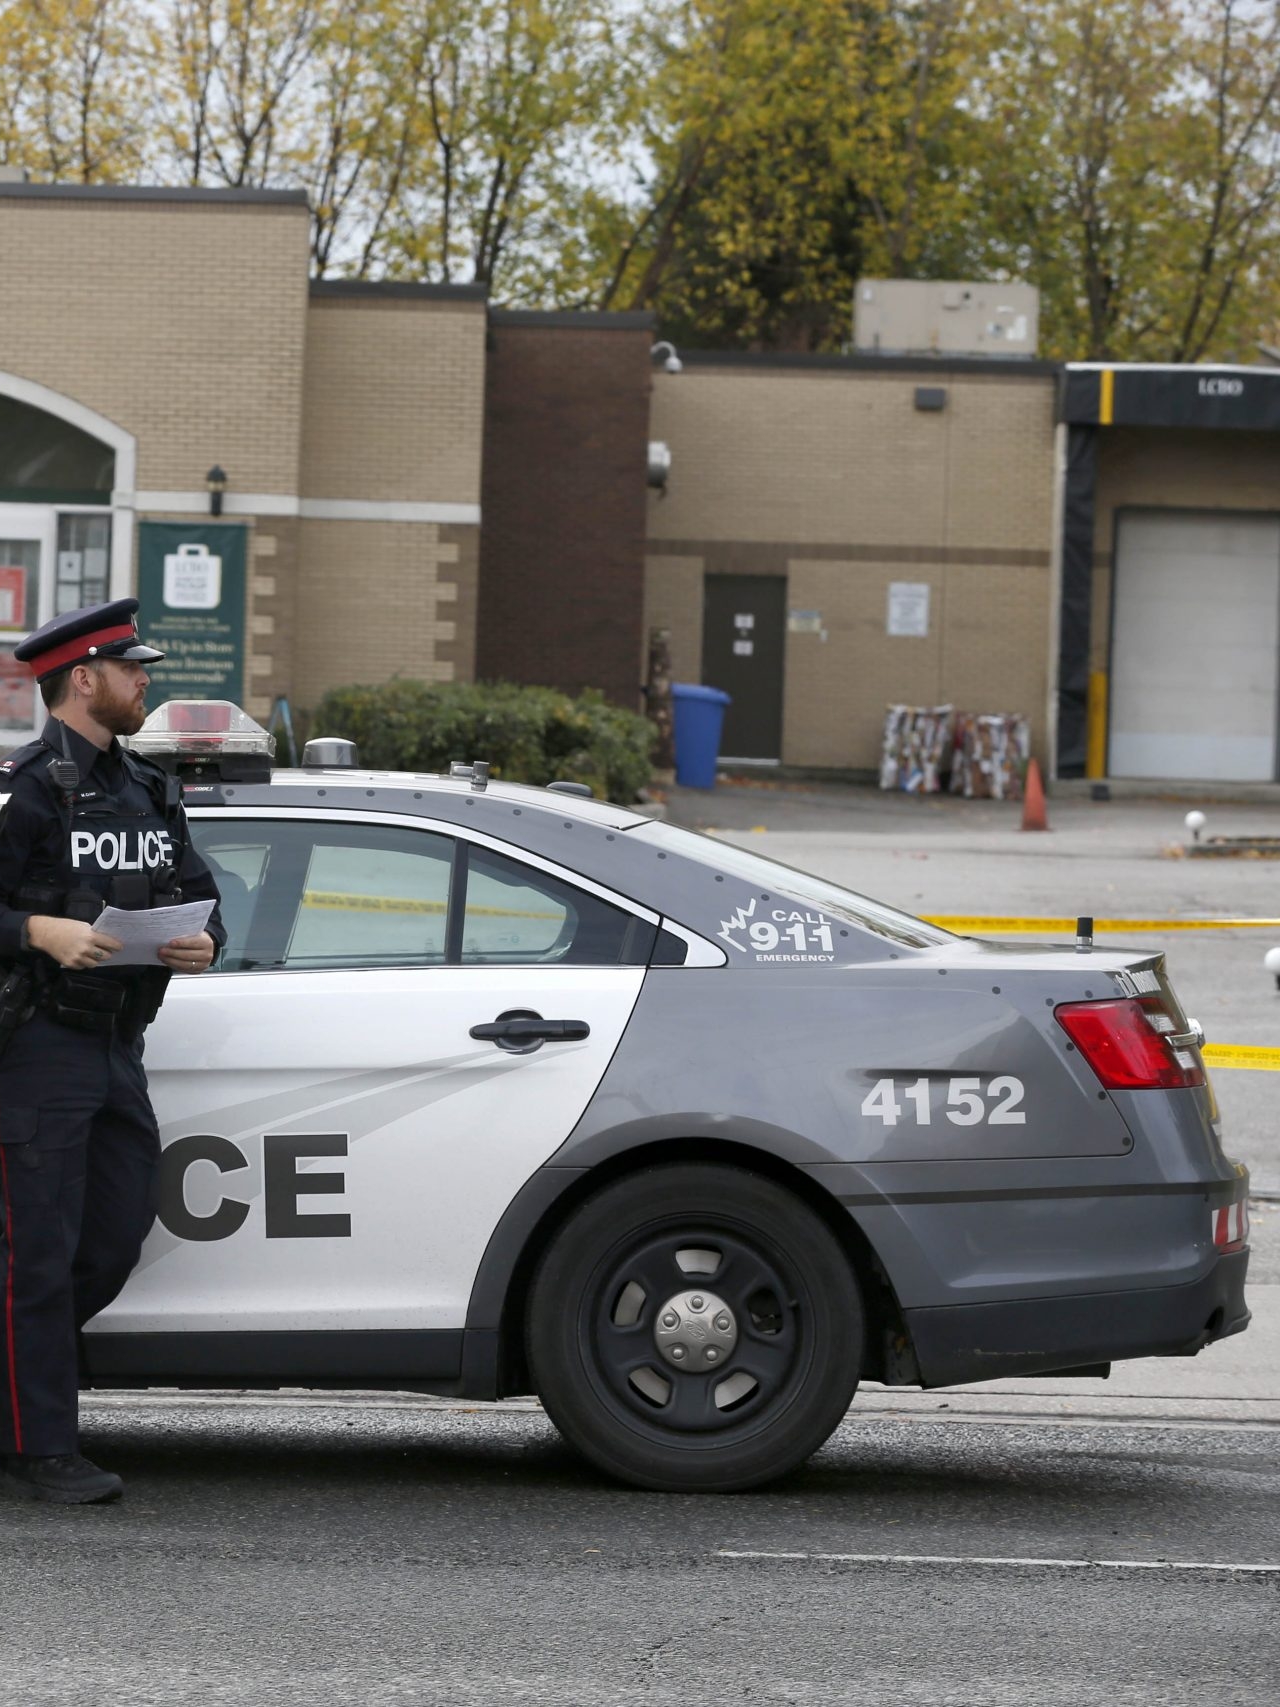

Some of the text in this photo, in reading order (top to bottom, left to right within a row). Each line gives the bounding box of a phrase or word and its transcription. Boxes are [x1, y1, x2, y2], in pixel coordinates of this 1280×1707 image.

[71, 831, 173, 870] POLICE
[771, 910, 832, 926] CALL
[749, 922, 834, 952] 9-1-1
[755, 954, 835, 962] EMERGENCY
[861, 1076, 1026, 1126] 4152
